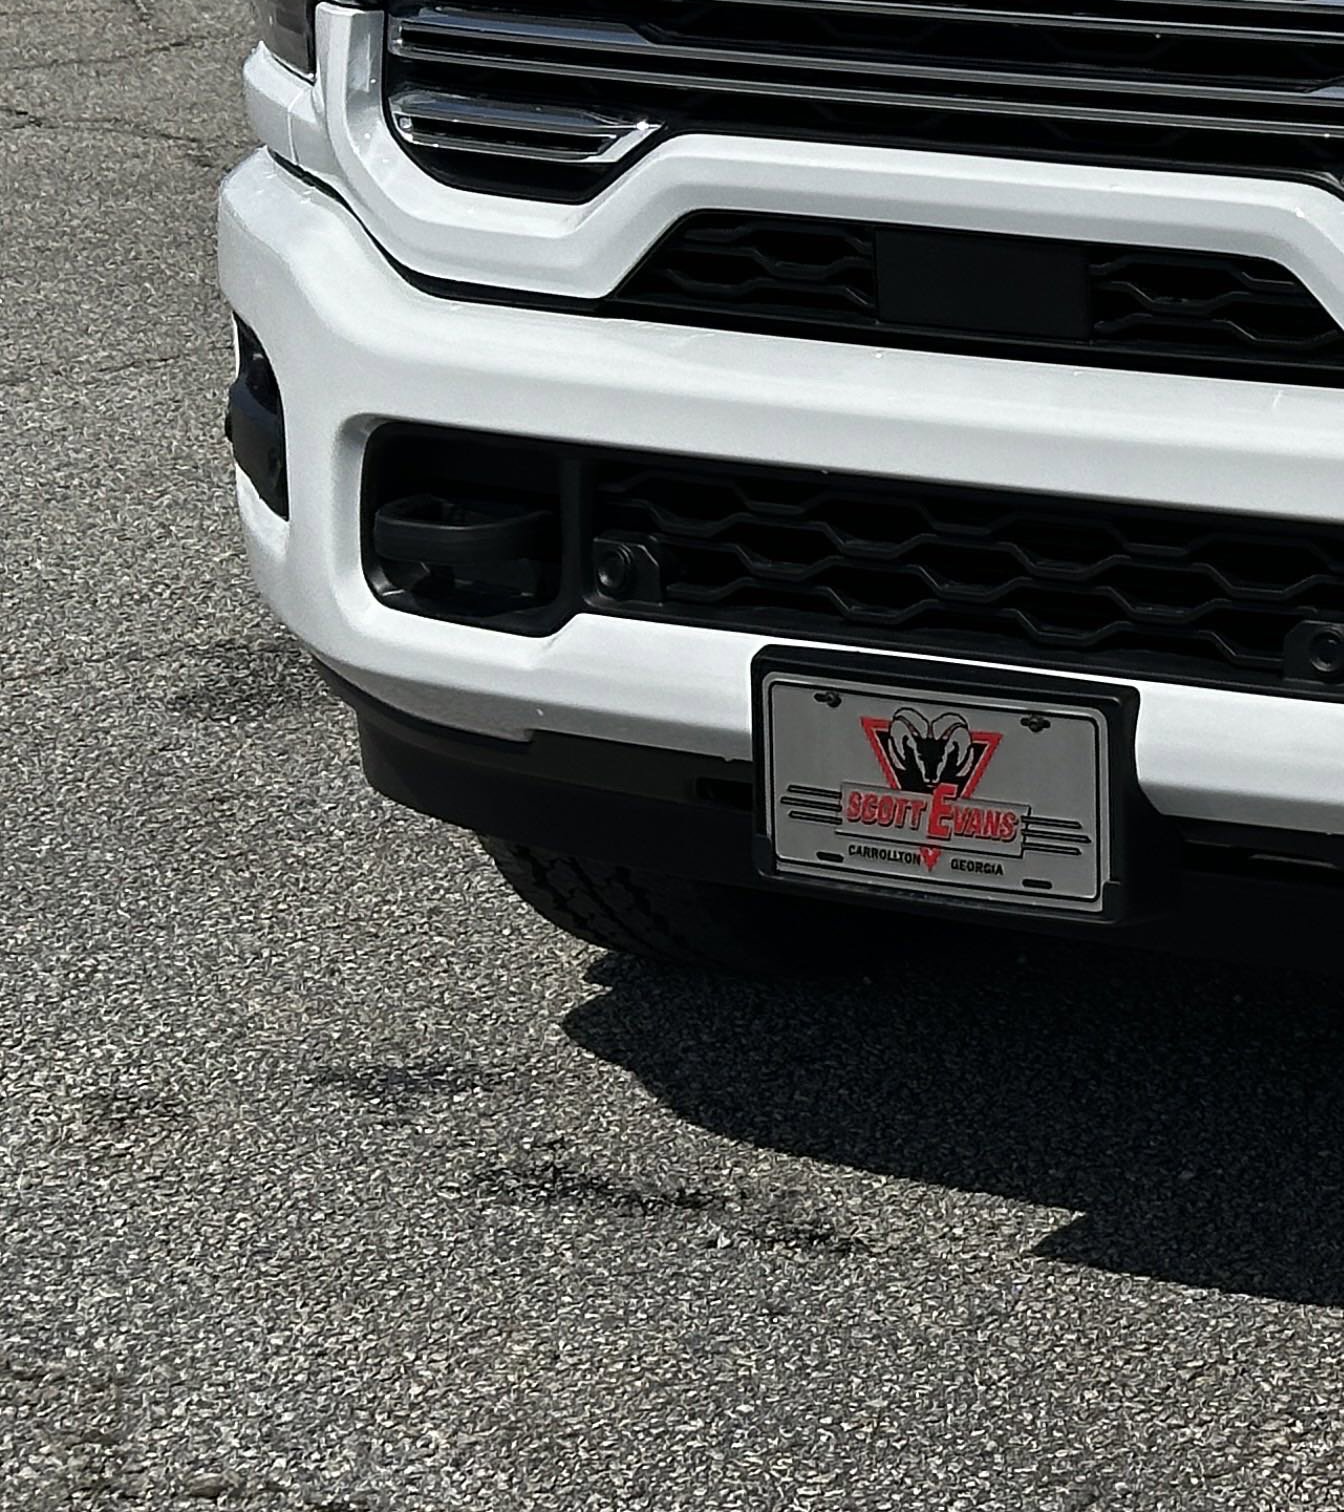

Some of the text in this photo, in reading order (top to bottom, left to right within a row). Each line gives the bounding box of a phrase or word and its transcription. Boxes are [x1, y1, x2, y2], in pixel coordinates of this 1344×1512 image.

[846, 782, 1019, 844] SCOTT EVANS
[848, 844, 1005, 876] CARROLLTON GEORGIA
